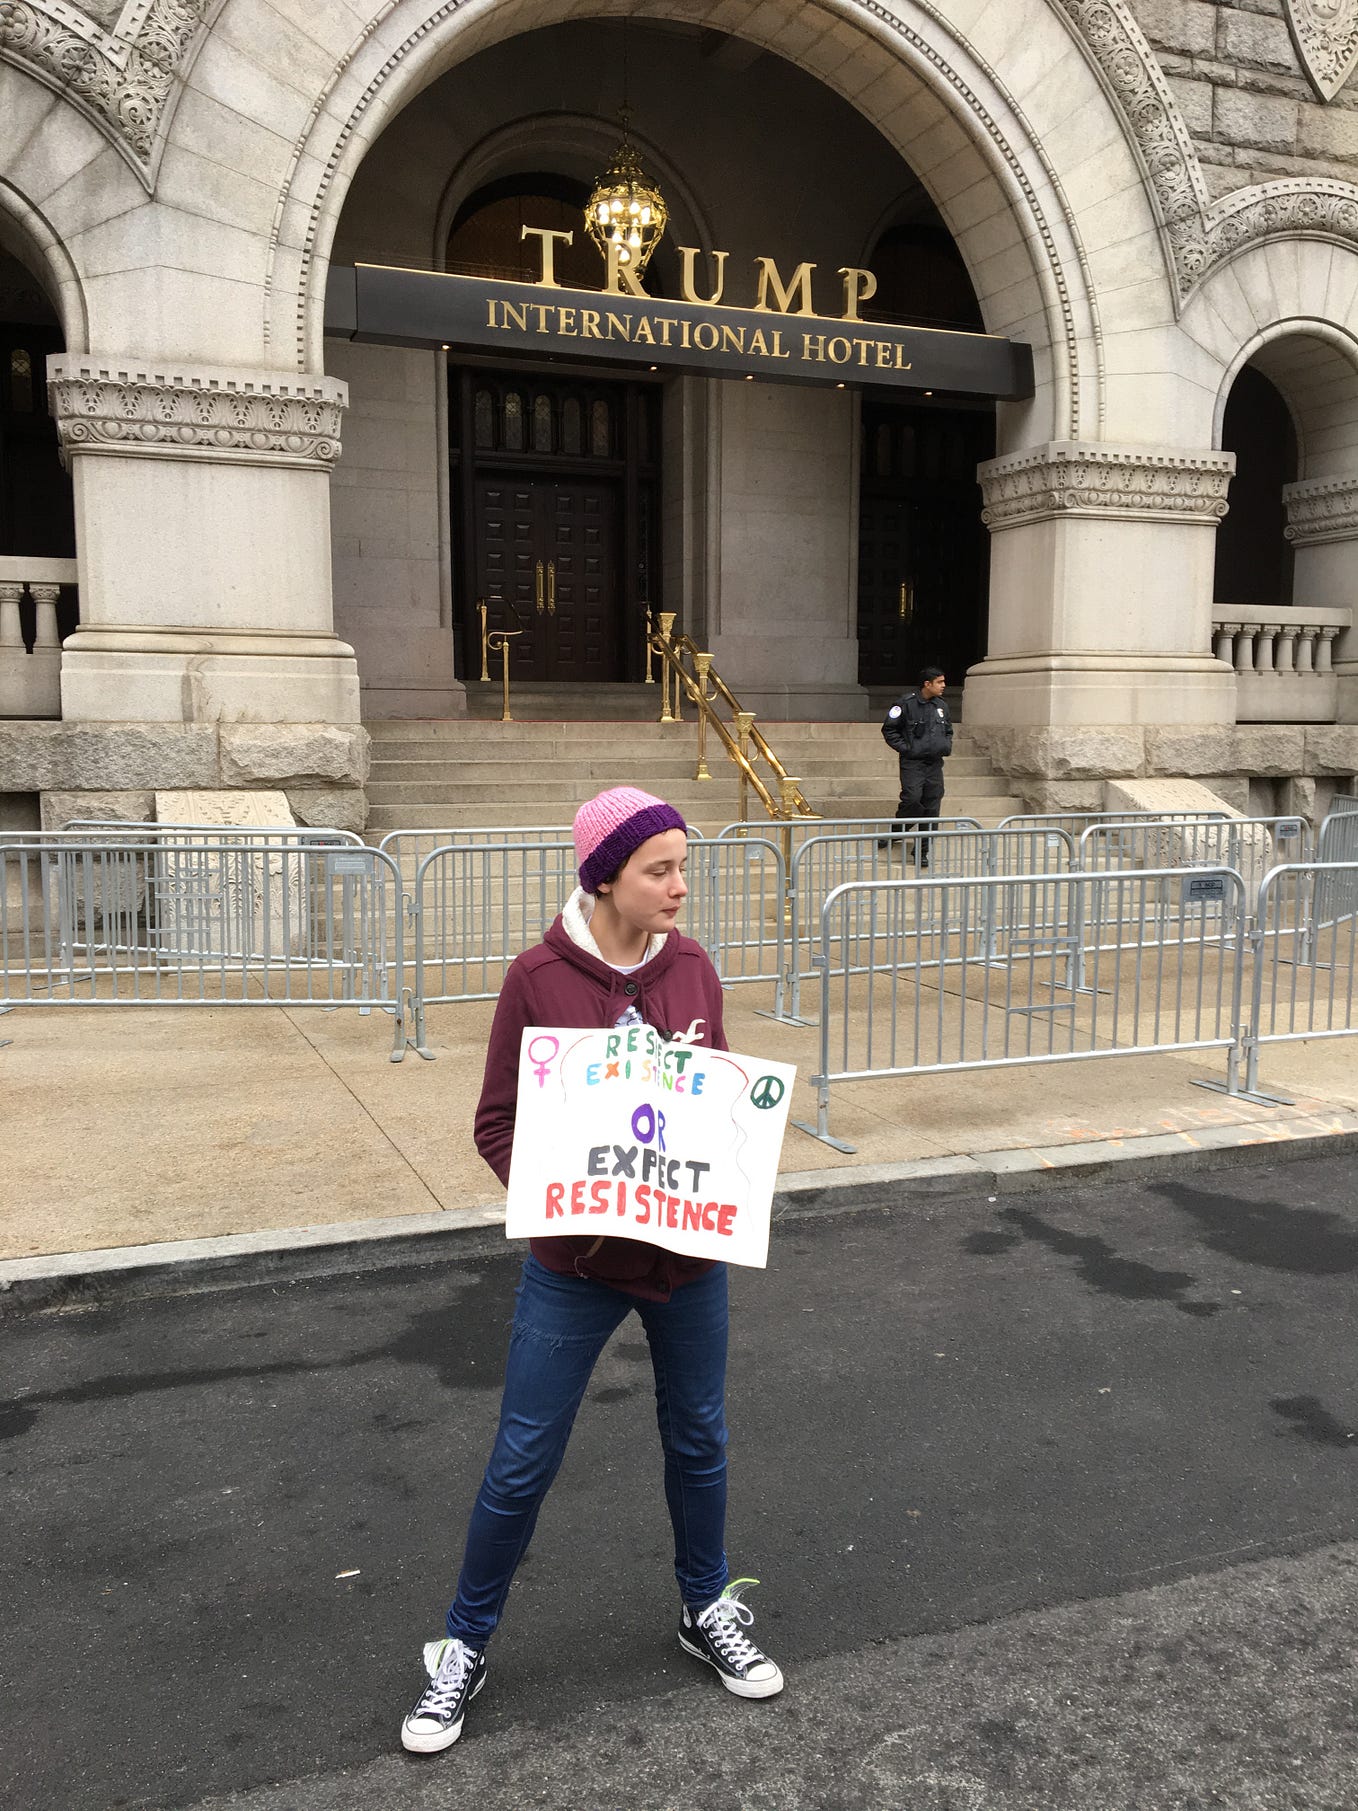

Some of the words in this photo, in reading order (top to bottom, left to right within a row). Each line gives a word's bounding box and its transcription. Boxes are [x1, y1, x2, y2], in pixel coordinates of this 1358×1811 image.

[521, 225, 877, 322] TRUMP
[486, 299, 789, 358] INTERNATIONAL
[802, 334, 912, 370] HOTEL
[631, 1103, 666, 1152] OR
[587, 1144, 710, 1193] EXPECT
[545, 1180, 738, 1236] RESISTENCE
